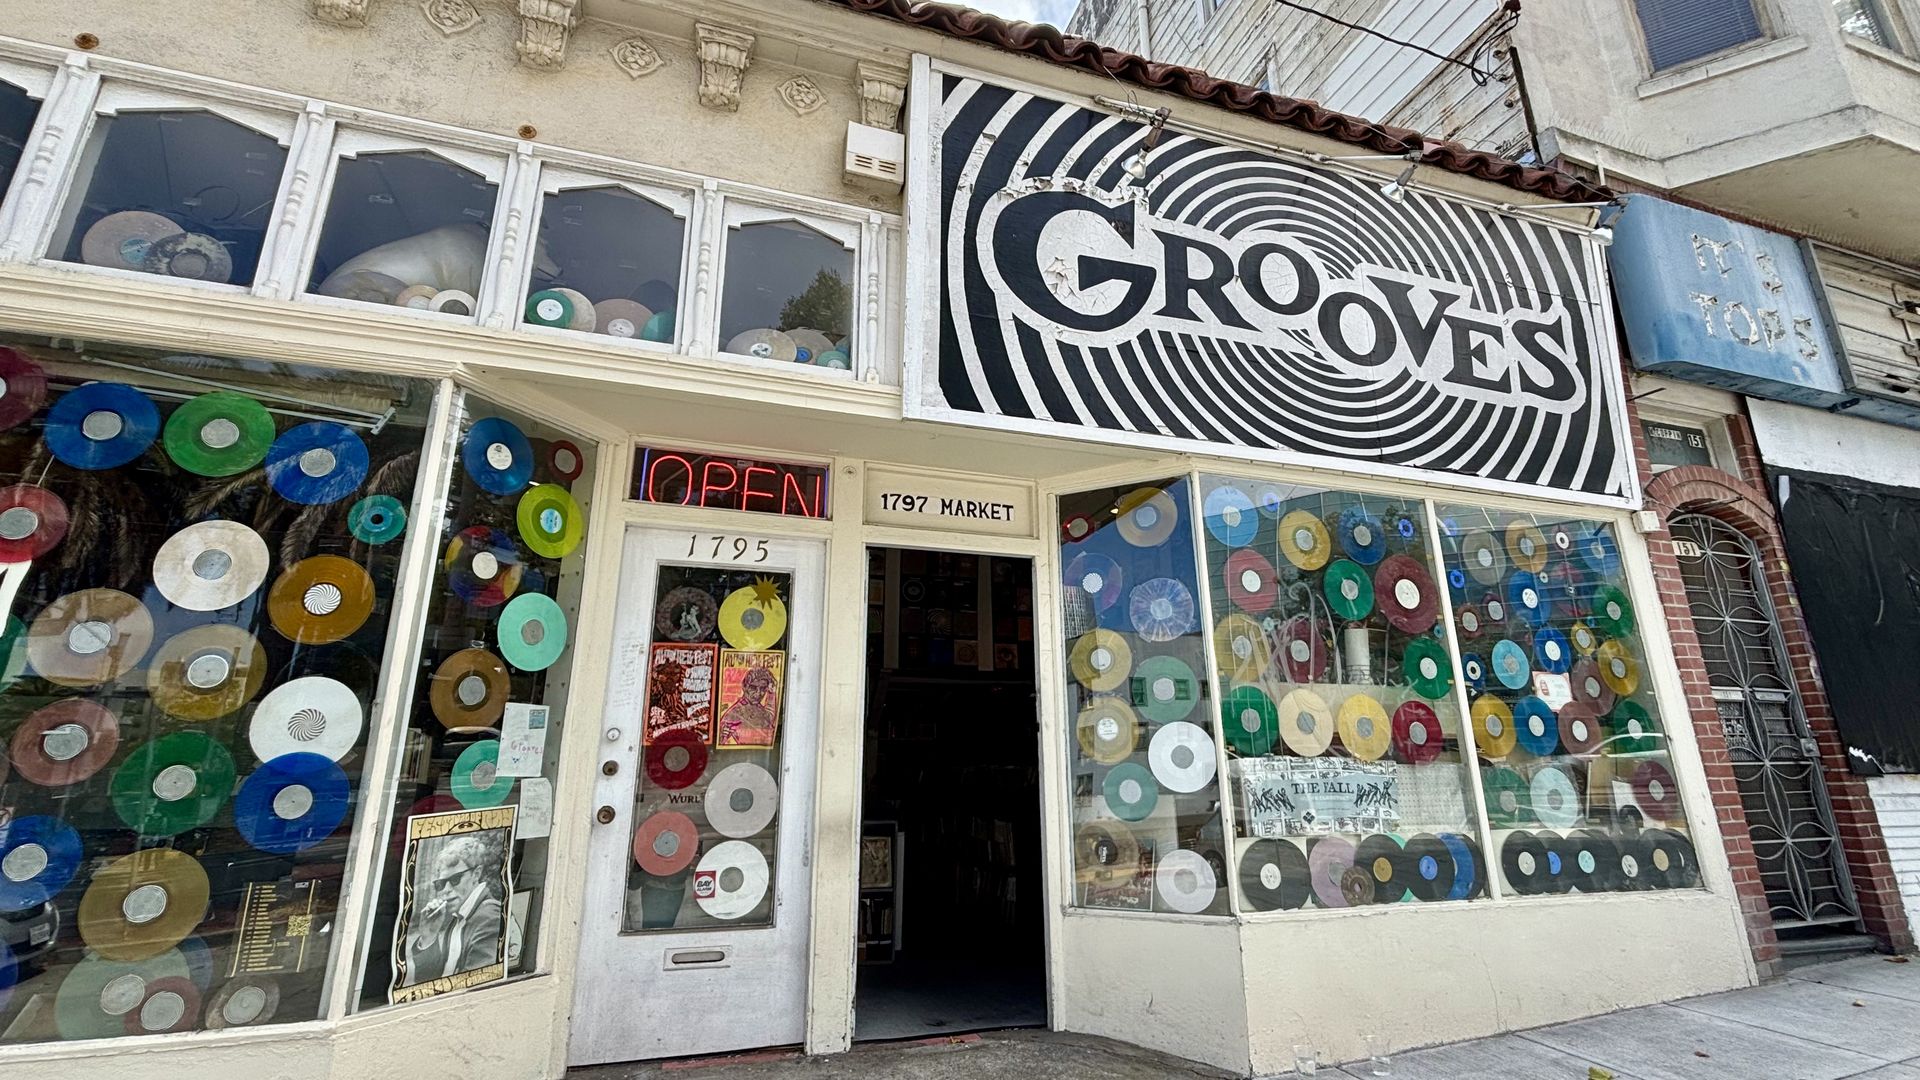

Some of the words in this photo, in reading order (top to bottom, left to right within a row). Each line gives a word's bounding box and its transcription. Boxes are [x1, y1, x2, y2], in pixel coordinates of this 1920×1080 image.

[994, 190, 1578, 401] GROOVES
[1688, 290, 1820, 362] TOPS
[1687, 434, 1704, 448] 151
[648, 455, 821, 519] OPEN
[881, 493, 928, 513] 1797
[940, 498, 1014, 521] MARKET
[687, 534, 769, 563] 1795
[1676, 541, 1697, 556] 151
[1291, 782, 1320, 795] THE
[1323, 782, 1354, 794] FALL
[697, 880, 712, 888] BAY
